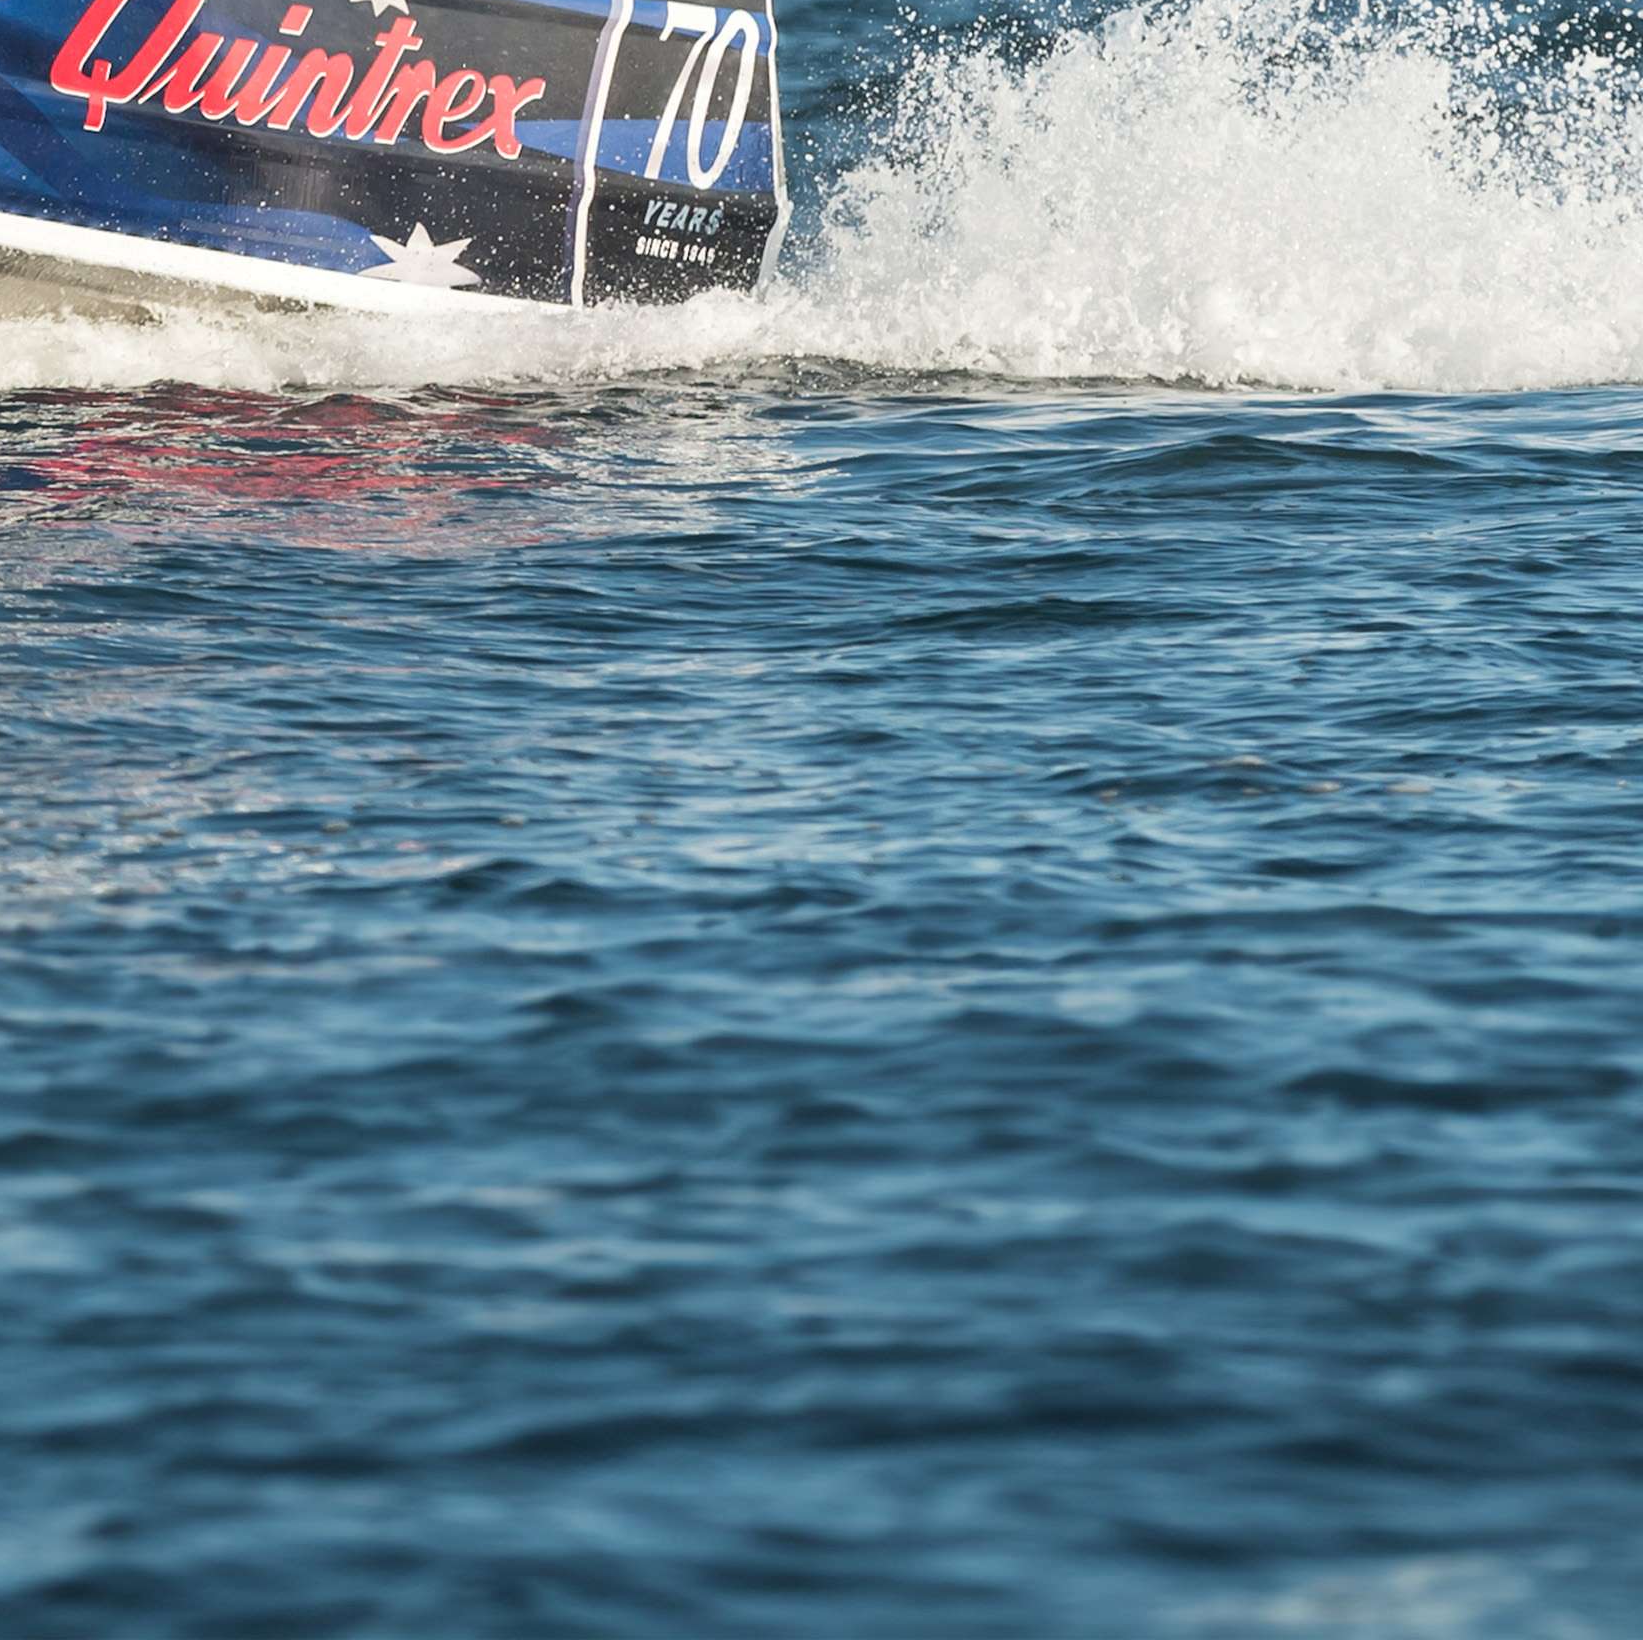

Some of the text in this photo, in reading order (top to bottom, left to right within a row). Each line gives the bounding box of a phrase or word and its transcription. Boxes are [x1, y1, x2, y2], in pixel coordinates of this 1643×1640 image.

[643, 0, 761, 190] 70
[643, 199, 724, 236] YEARS
[635, 236, 716, 267] SINCE 1945
